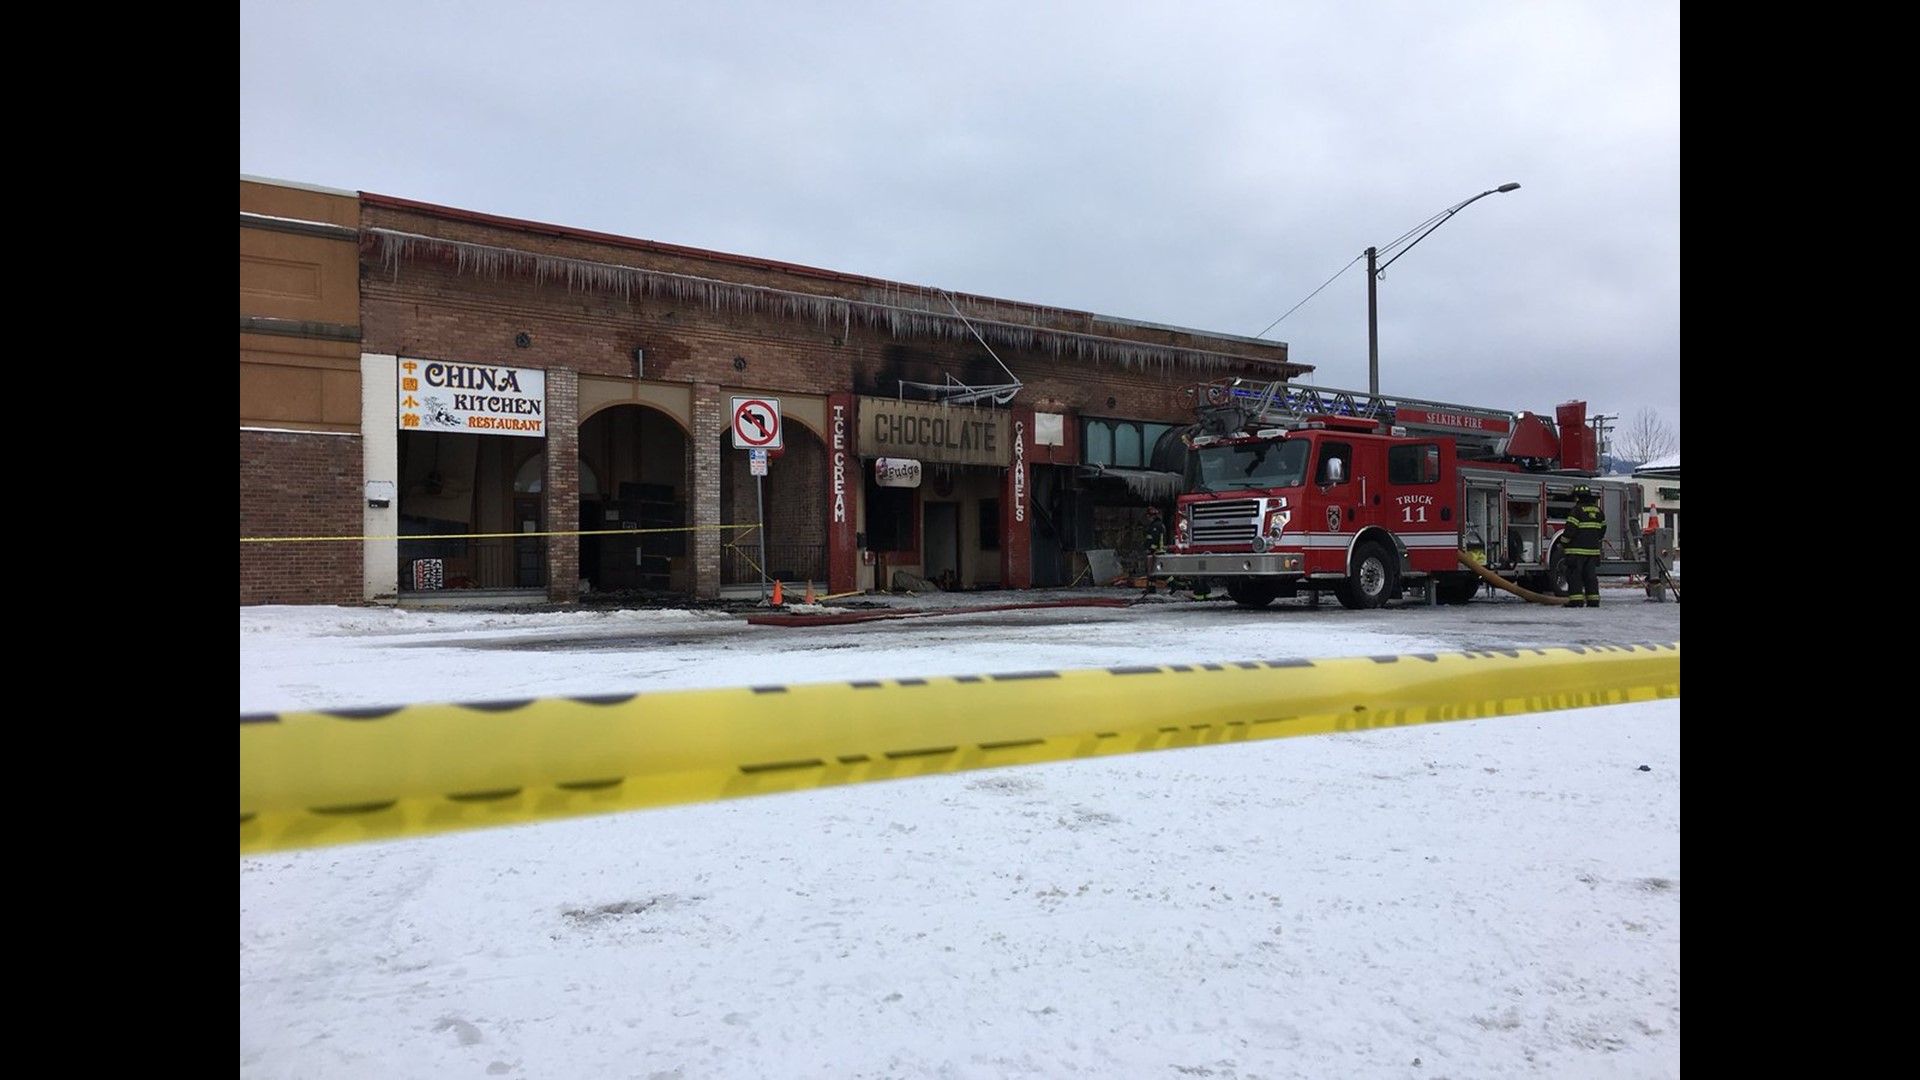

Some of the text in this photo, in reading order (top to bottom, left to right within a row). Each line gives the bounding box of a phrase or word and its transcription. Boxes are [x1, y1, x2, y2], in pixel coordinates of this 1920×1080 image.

[425, 363, 522, 393] CHINA
[453, 394, 542, 415] KITCHEN
[468, 416, 542, 431] RESTAURANT
[1426, 412, 1483, 429] SELKIRK FIRE
[874, 413, 996, 451] CHOCOLATE
[833, 405, 845, 523] ICE CREAM
[888, 464, 920, 479] Fudge
[1015, 421, 1025, 522] CARAMELS
[1395, 495, 1433, 505] TRUCK
[1402, 506, 1428, 523] 11
